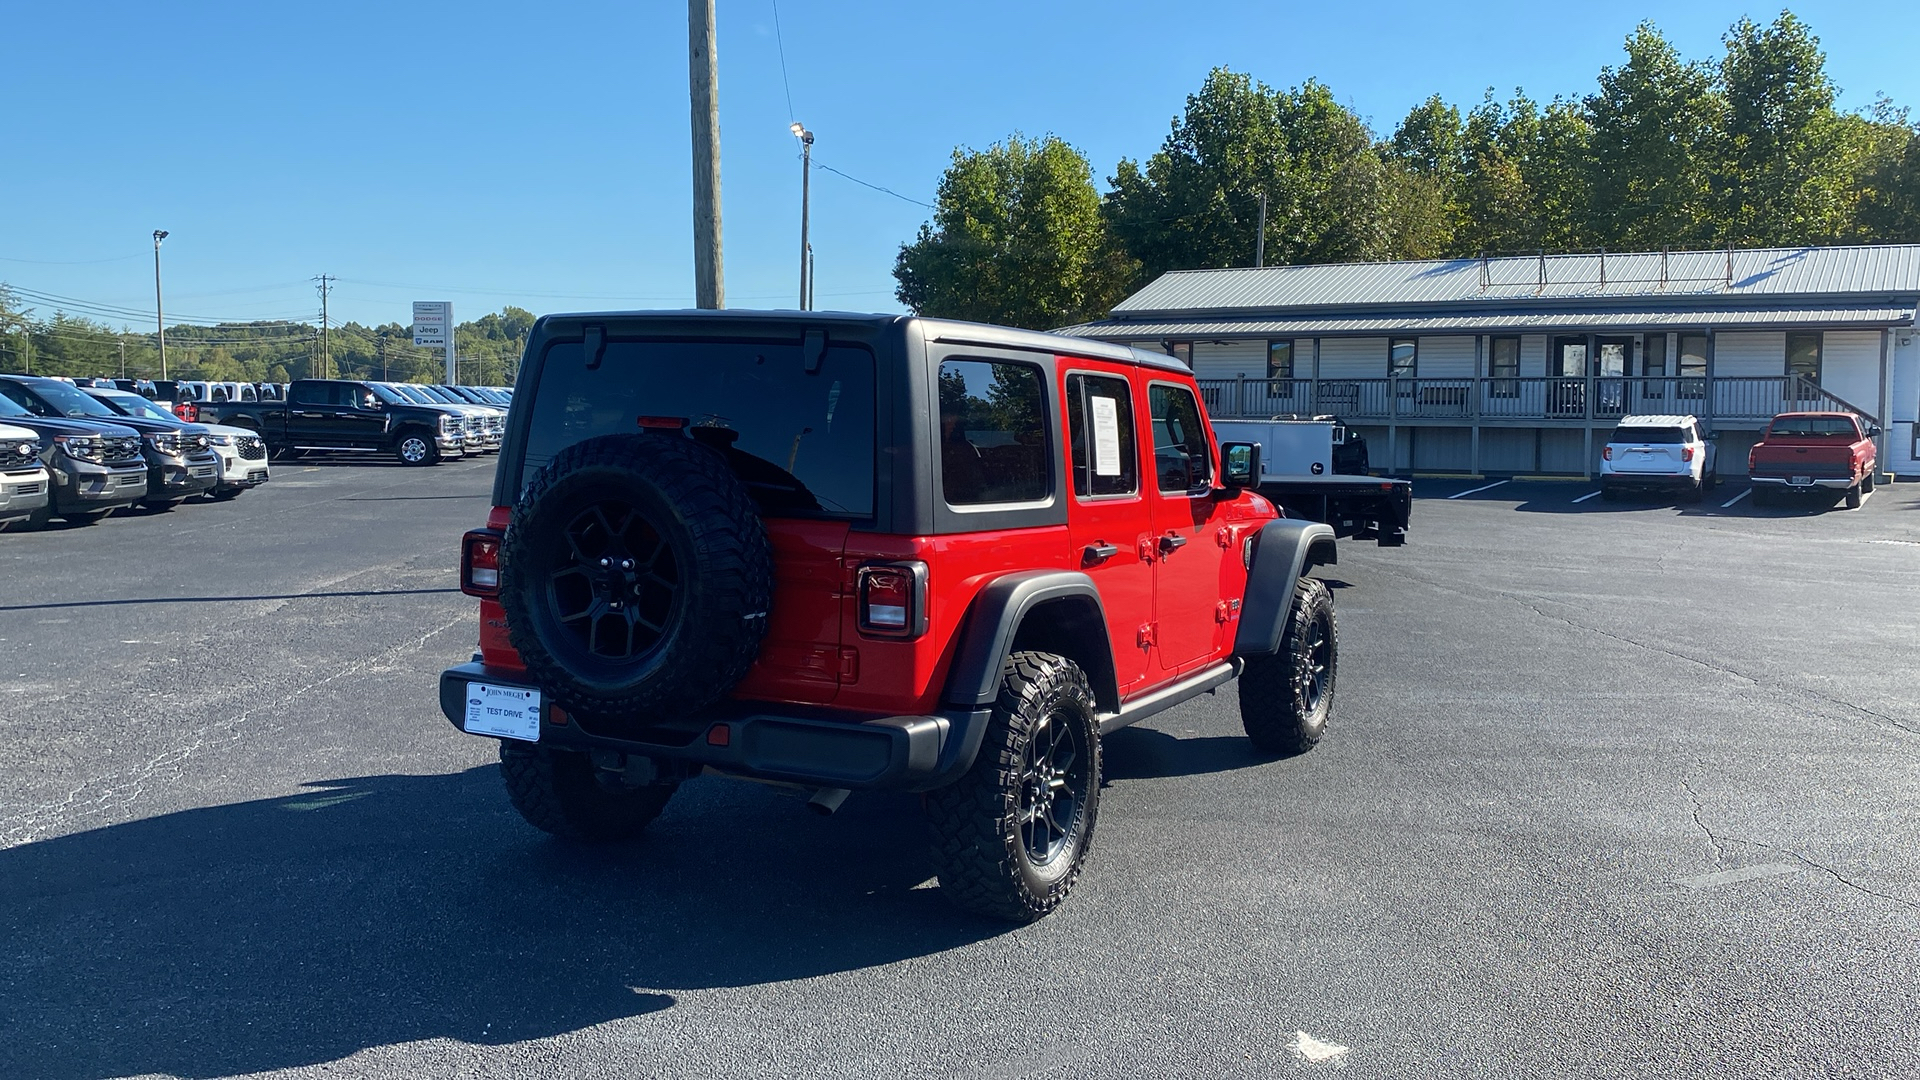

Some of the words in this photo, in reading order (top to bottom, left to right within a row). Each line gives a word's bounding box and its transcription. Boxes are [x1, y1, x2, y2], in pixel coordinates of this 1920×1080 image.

[419, 326, 438, 334] Jeep
[486, 688, 502, 697] JOHN
[503, 690, 525, 701] MEGEL
[486, 707, 502, 716] TEST
[504, 709, 523, 718] DRIVE
